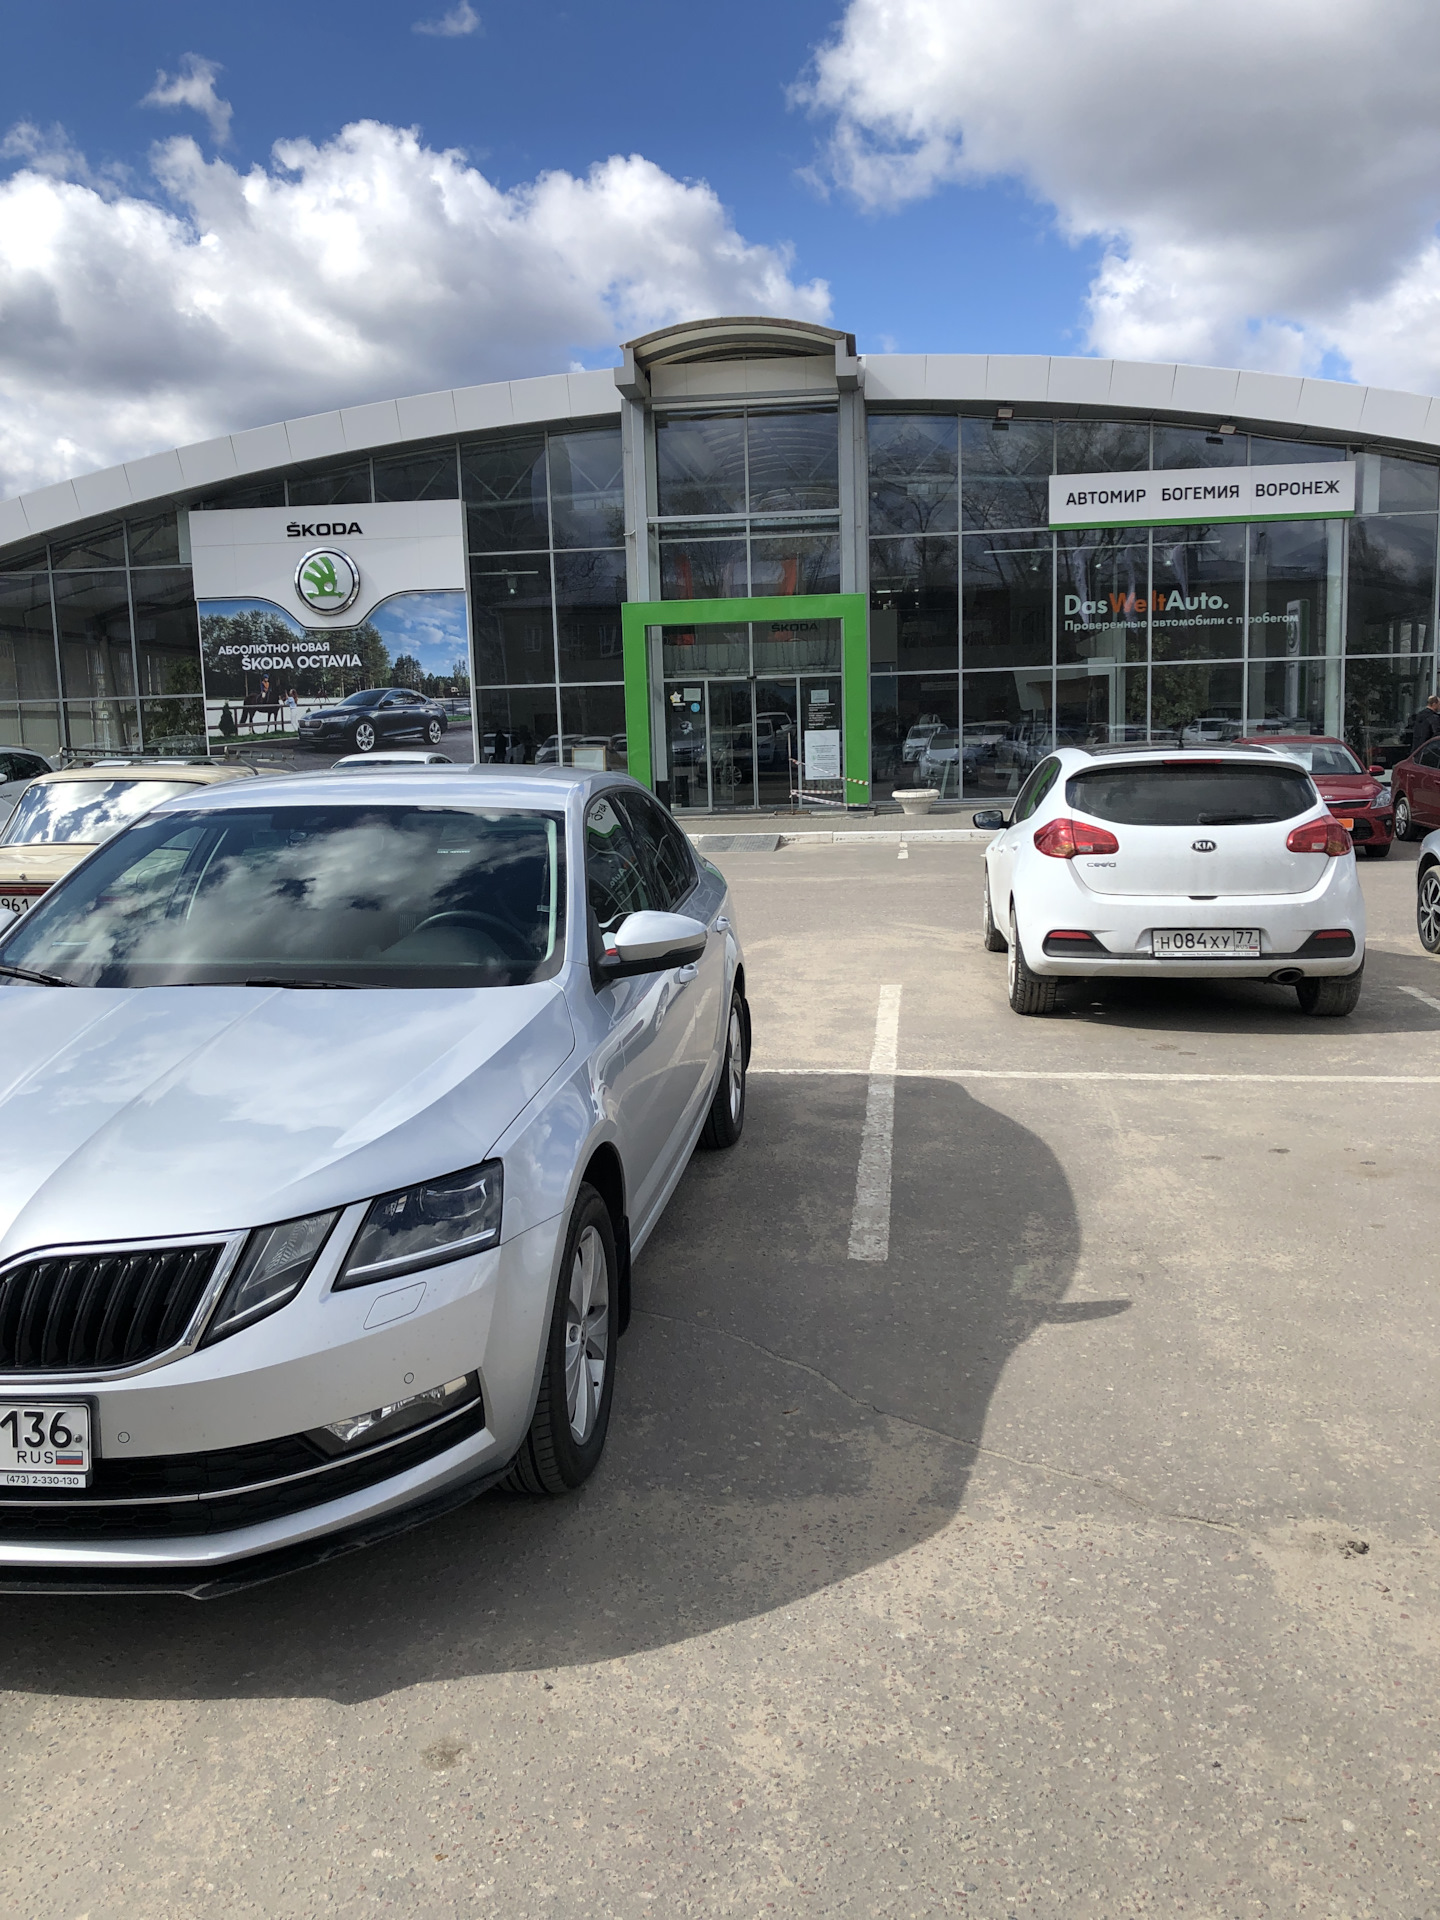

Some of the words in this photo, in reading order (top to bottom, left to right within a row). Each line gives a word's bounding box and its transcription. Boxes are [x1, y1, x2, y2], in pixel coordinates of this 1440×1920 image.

[1066, 489, 1147, 506] АВТОМИР
[1161, 485, 1240, 502] БОГЕМИЯ
[1255, 480, 1340, 498] ВОРОНЕЖ
[286, 521, 364, 538] ŠKODA
[1064, 619, 1148, 632] Проверенные
[1152, 614, 1225, 628] автомобили
[1226, 616, 1234, 625] с
[1235, 611, 1299, 626] пробегом
[218, 643, 290, 656] АБСОЛЮТНО
[291, 641, 330, 653] НОВАЯ
[241, 655, 294, 671] ŠKODA
[296, 653, 362, 669] OCTAVIA
[1194, 841, 1214, 851] KIA
[1, 898, 30, 913] 961
[1236, 931, 1254, 944] 77
[0, 1410, 73, 1449] 136
[16, 1450, 54, 1464] RUS
[6, 1474, 30, 1485] (473)
[32, 1475, 79, 1485] 2-330-130
